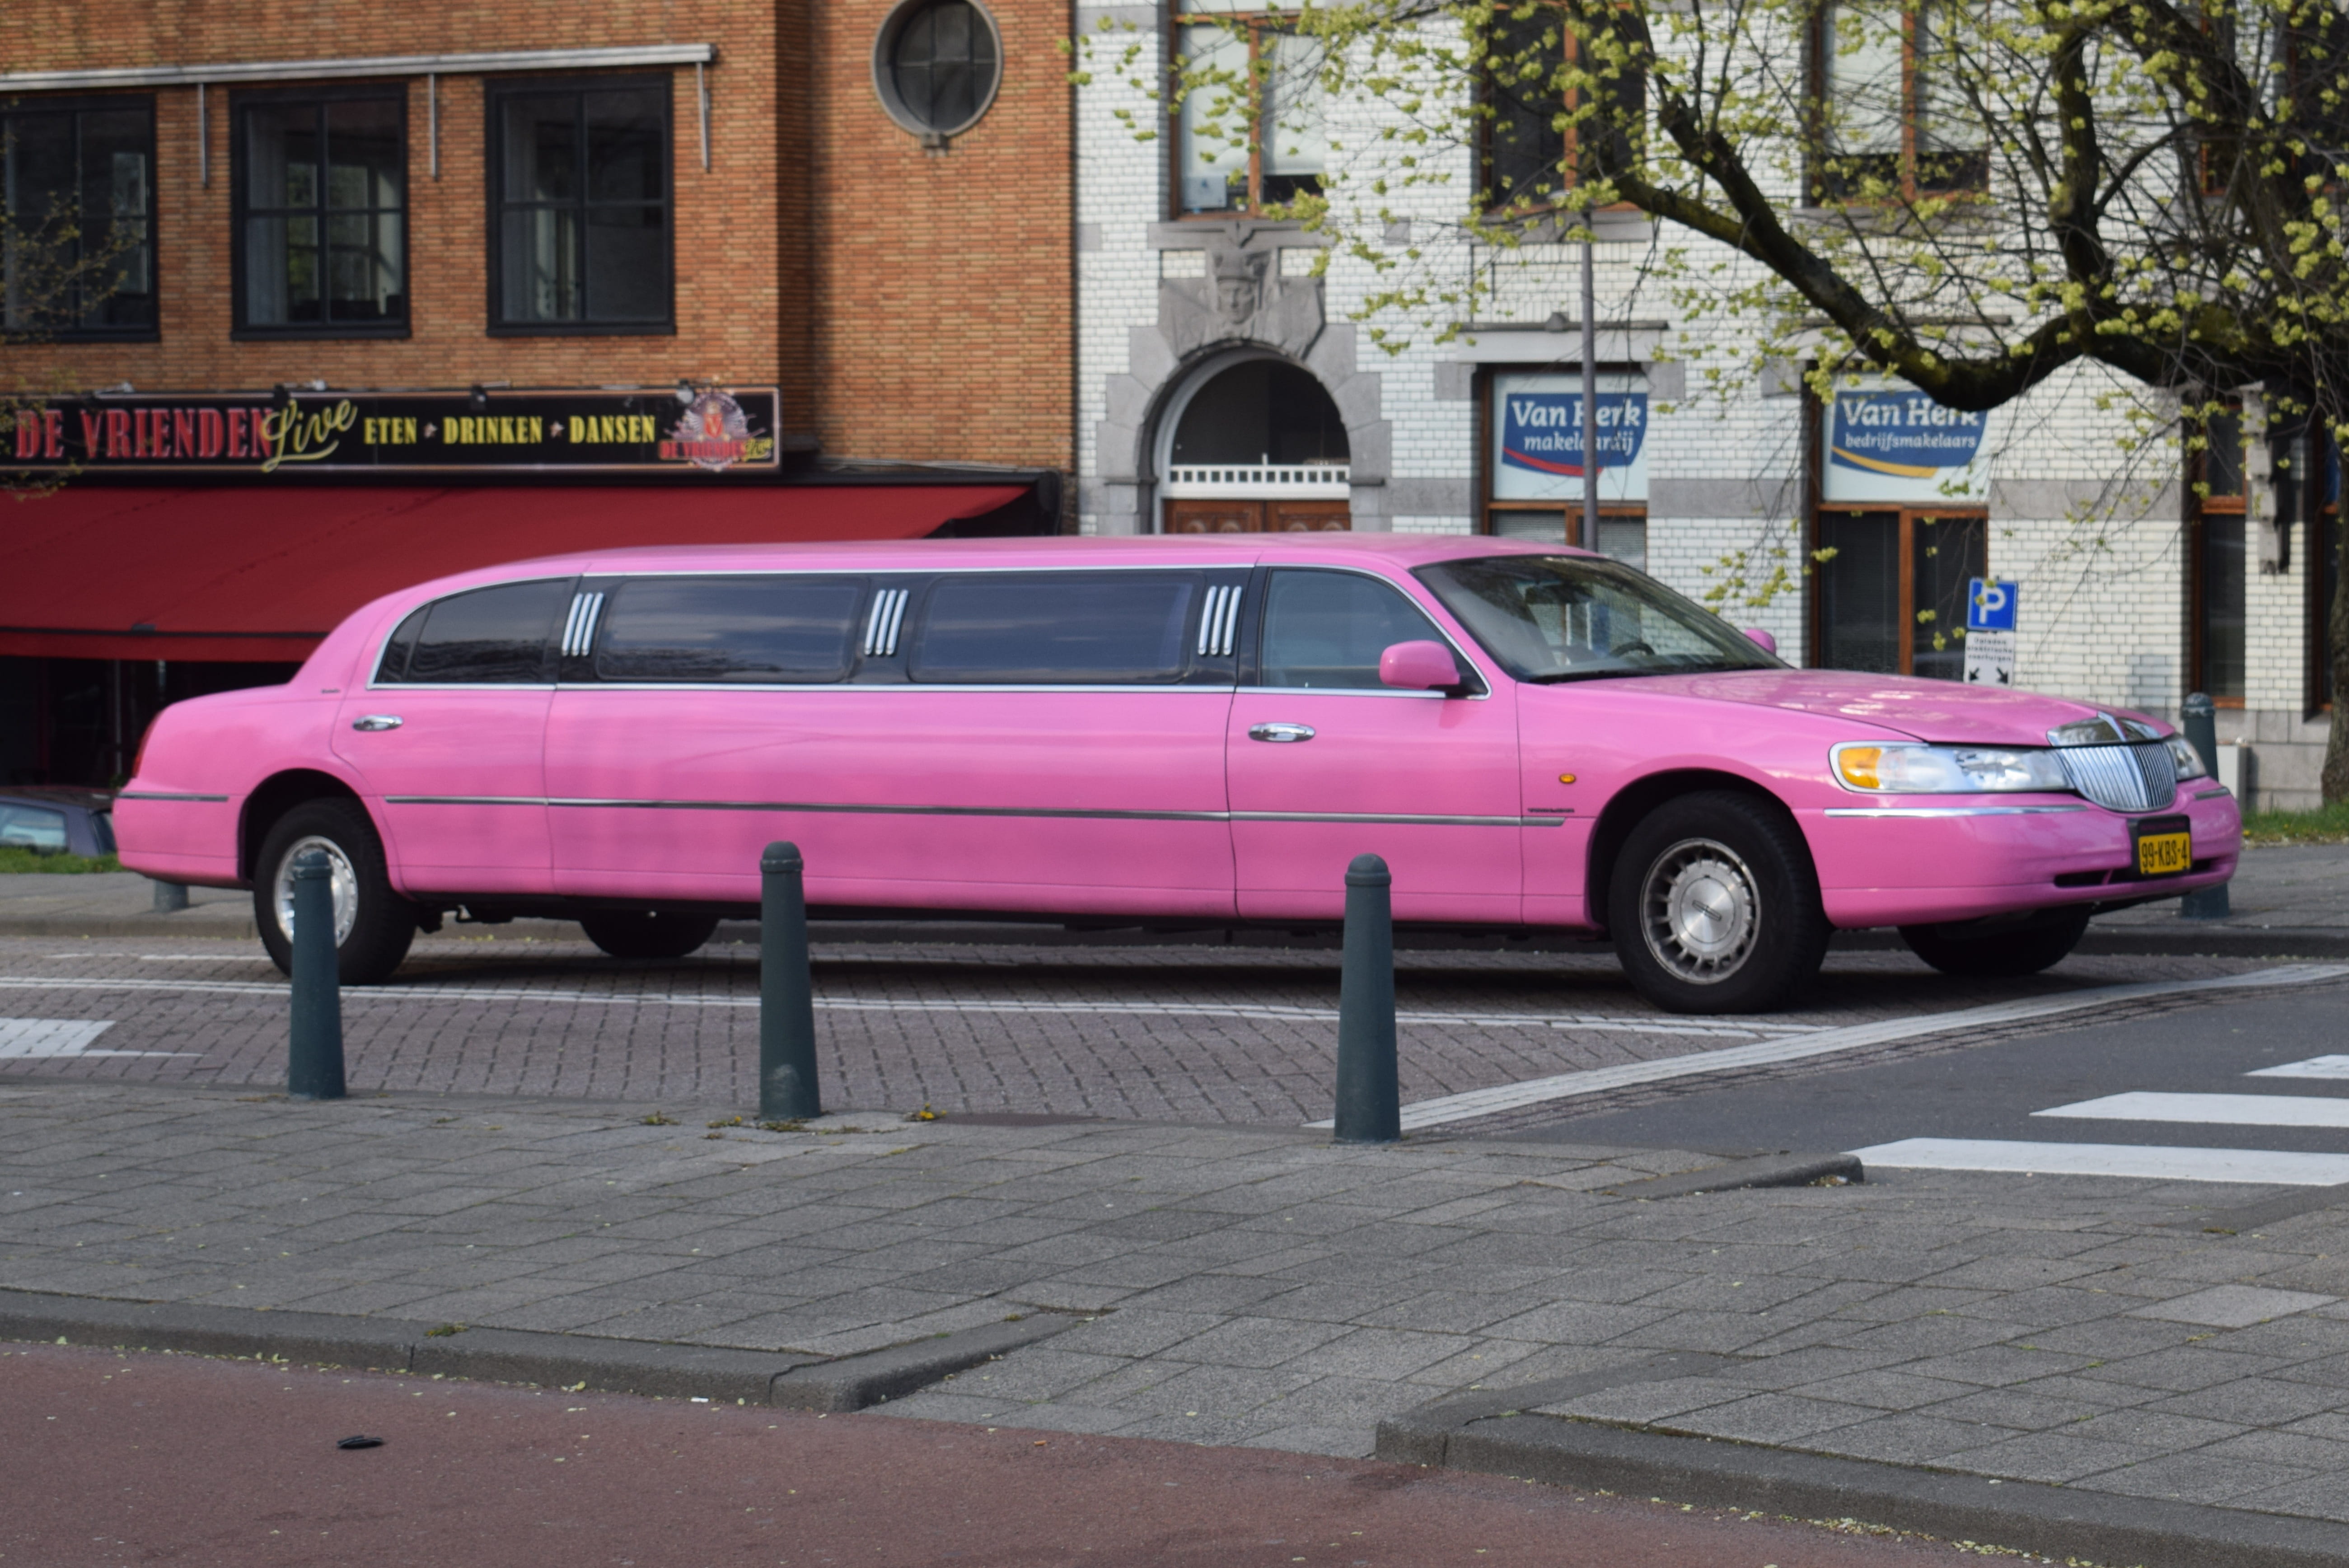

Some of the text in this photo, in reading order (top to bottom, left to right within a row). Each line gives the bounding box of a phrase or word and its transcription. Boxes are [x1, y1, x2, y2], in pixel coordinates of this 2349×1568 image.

[1511, 400, 1567, 427] Van
[1841, 398, 1900, 426] Van
[15, 398, 358, 473] DE VRIENDEN Live
[364, 415, 655, 444] ETEN DRINKEN DANSEN
[1845, 432, 1975, 451] bedrijfsmakelaars
[660, 440, 677, 458] DE
[1979, 585, 2006, 624] P
[2142, 839, 2188, 868] 99-KBS-4
